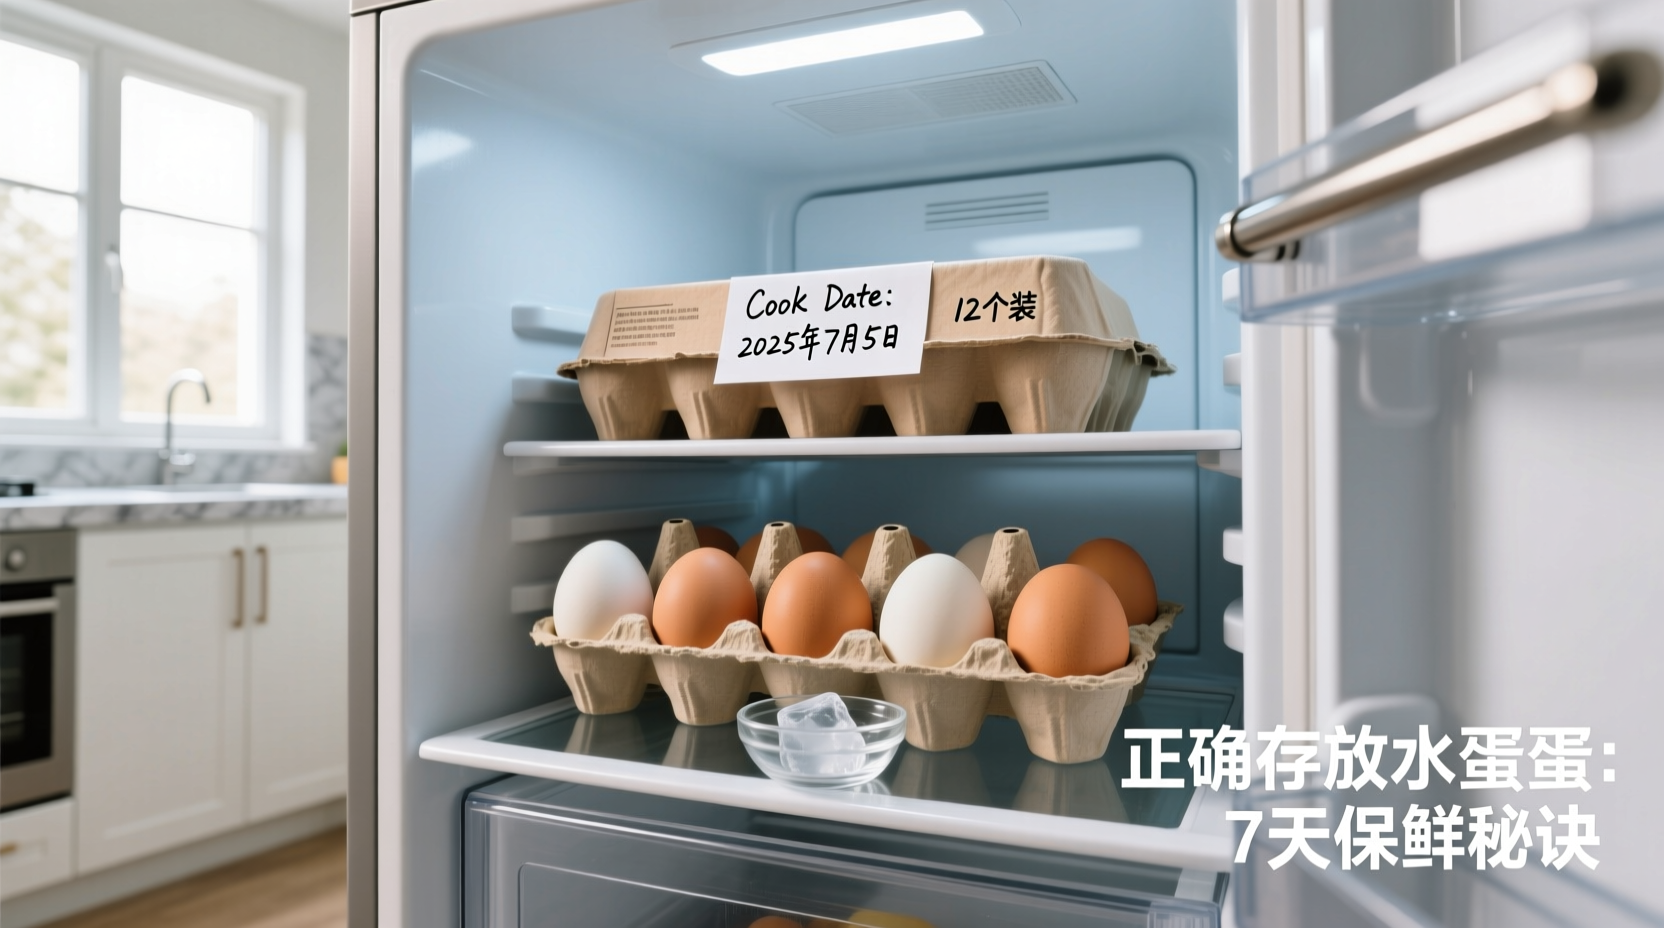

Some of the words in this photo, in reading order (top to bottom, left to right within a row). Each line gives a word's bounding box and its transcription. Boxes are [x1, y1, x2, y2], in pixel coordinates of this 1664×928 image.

[746, 285, 808, 320] Cook
[824, 283, 893, 312] Date:
[954, 290, 1038, 323] 12个装
[737, 322, 899, 361] 2025年7月5日
